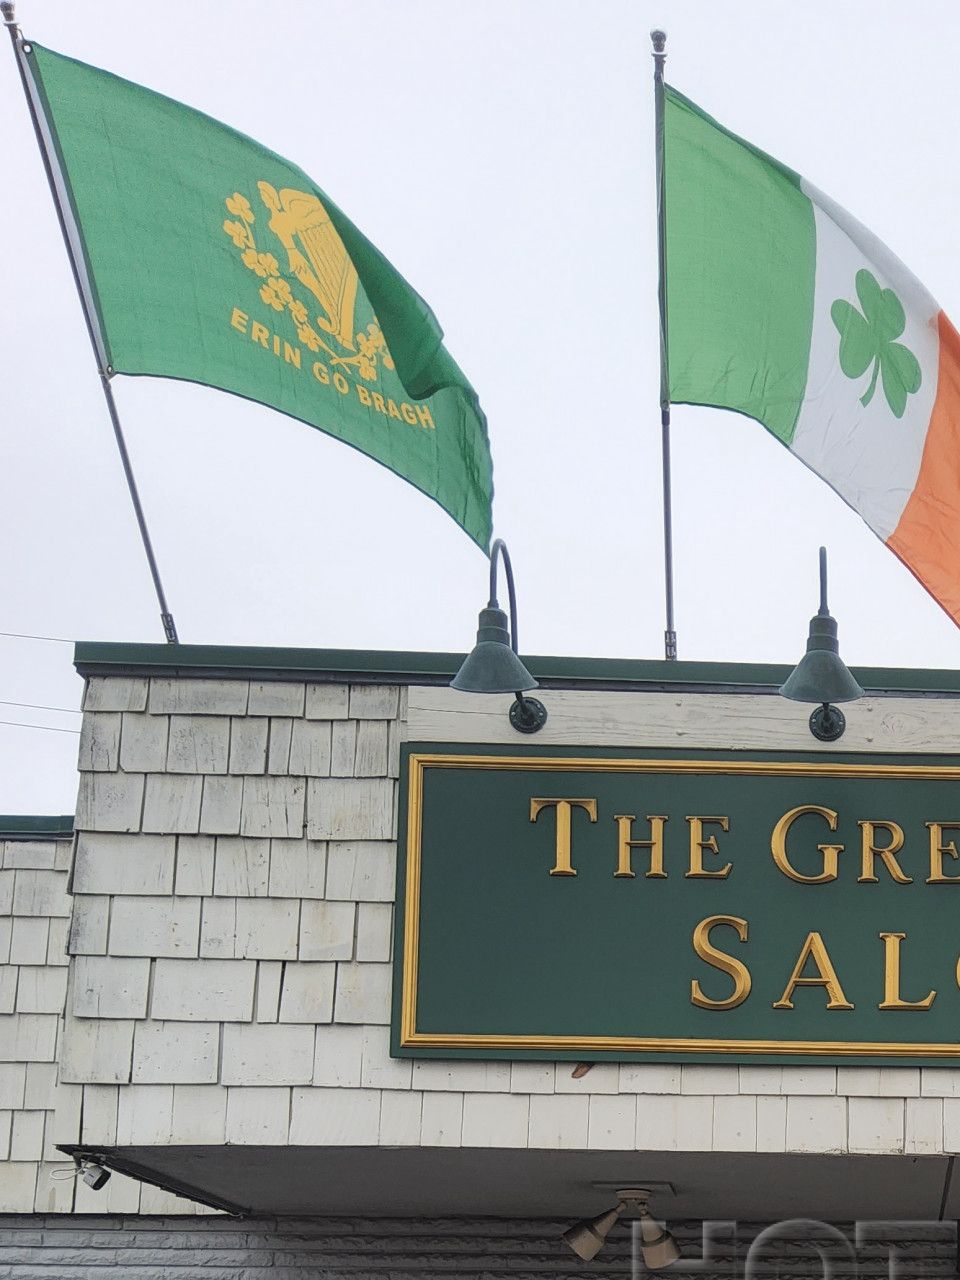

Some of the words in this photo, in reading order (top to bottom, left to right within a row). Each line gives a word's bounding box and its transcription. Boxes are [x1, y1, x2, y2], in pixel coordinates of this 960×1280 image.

[230, 307, 302, 369] ERIN
[311, 362, 350, 394] GO
[356, 385, 436, 429] BRAGH
[529, 797, 734, 880] THE
